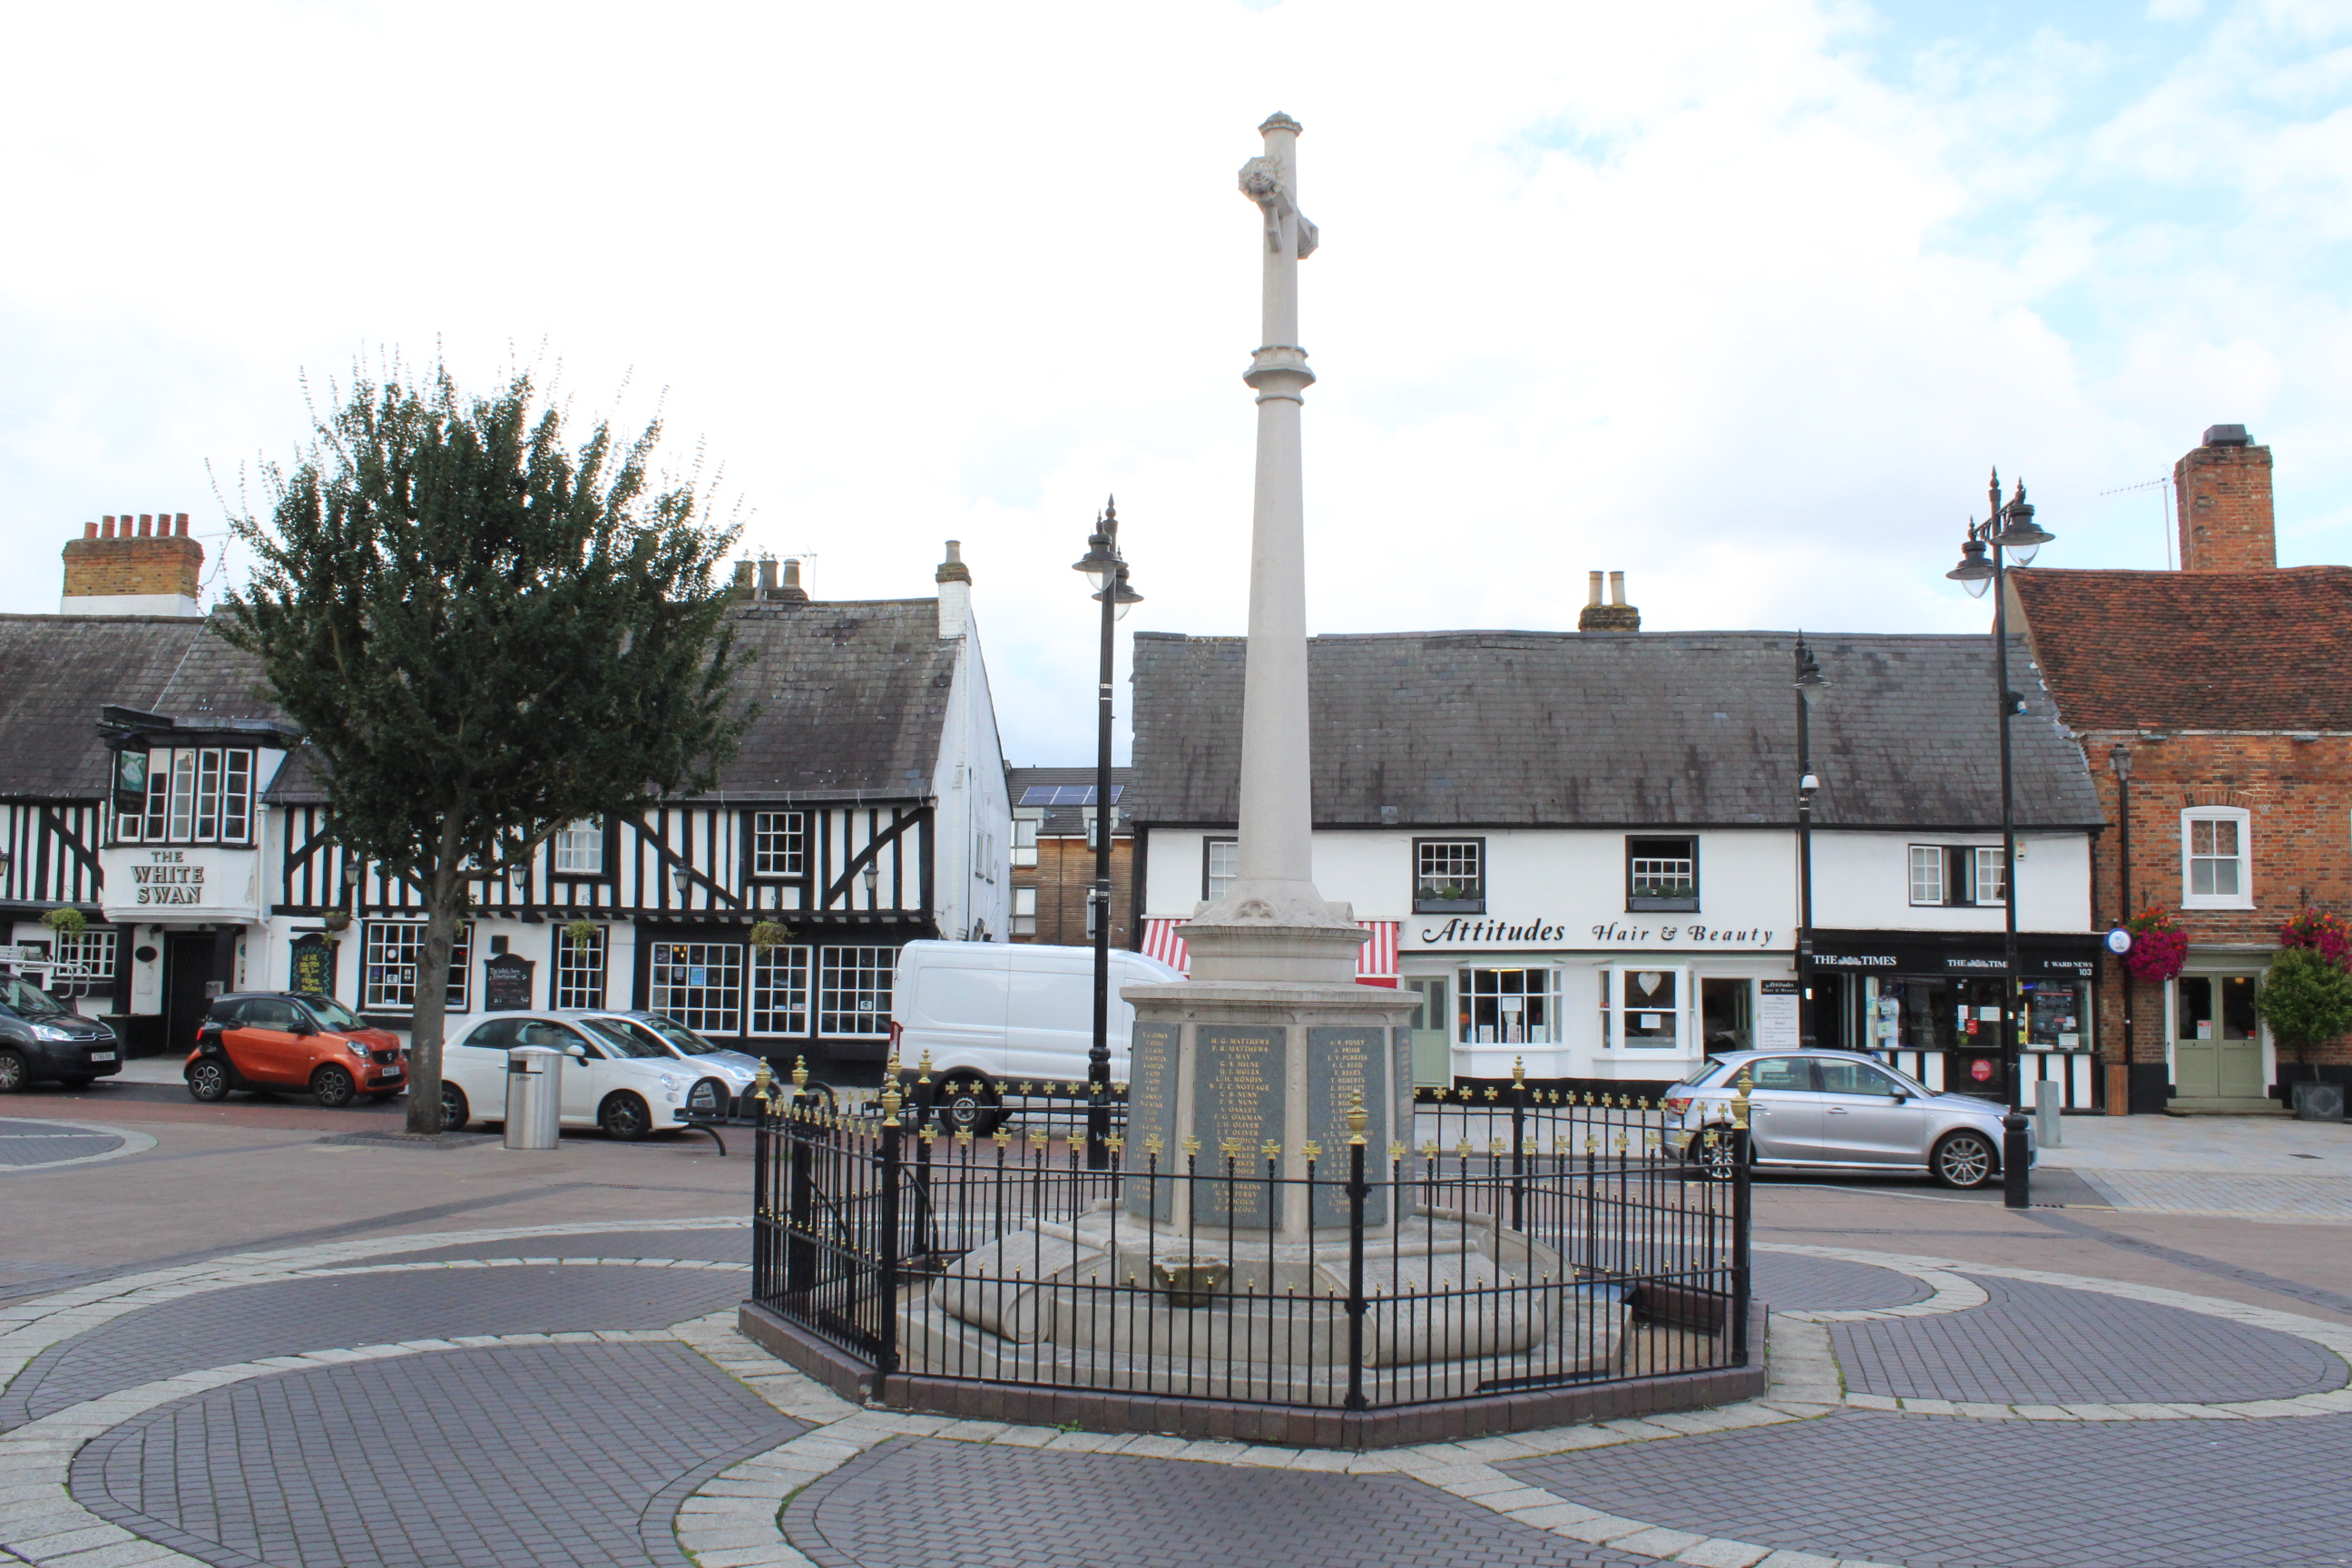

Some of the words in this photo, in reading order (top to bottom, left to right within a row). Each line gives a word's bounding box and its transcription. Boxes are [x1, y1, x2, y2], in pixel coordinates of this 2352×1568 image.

[151, 851, 183, 862] THE
[131, 867, 204, 883] WHITE
[137, 887, 201, 904] SWAN
[1422, 918, 1564, 943] Attitudes
[1592, 922, 1649, 941] Hair
[1661, 926, 1677, 941] &
[1688, 926, 1772, 946] Beauty
[1813, 956, 1838, 965] THE
[1861, 956, 1896, 965] TIMES
[1988, 960, 2008, 968] TIM
